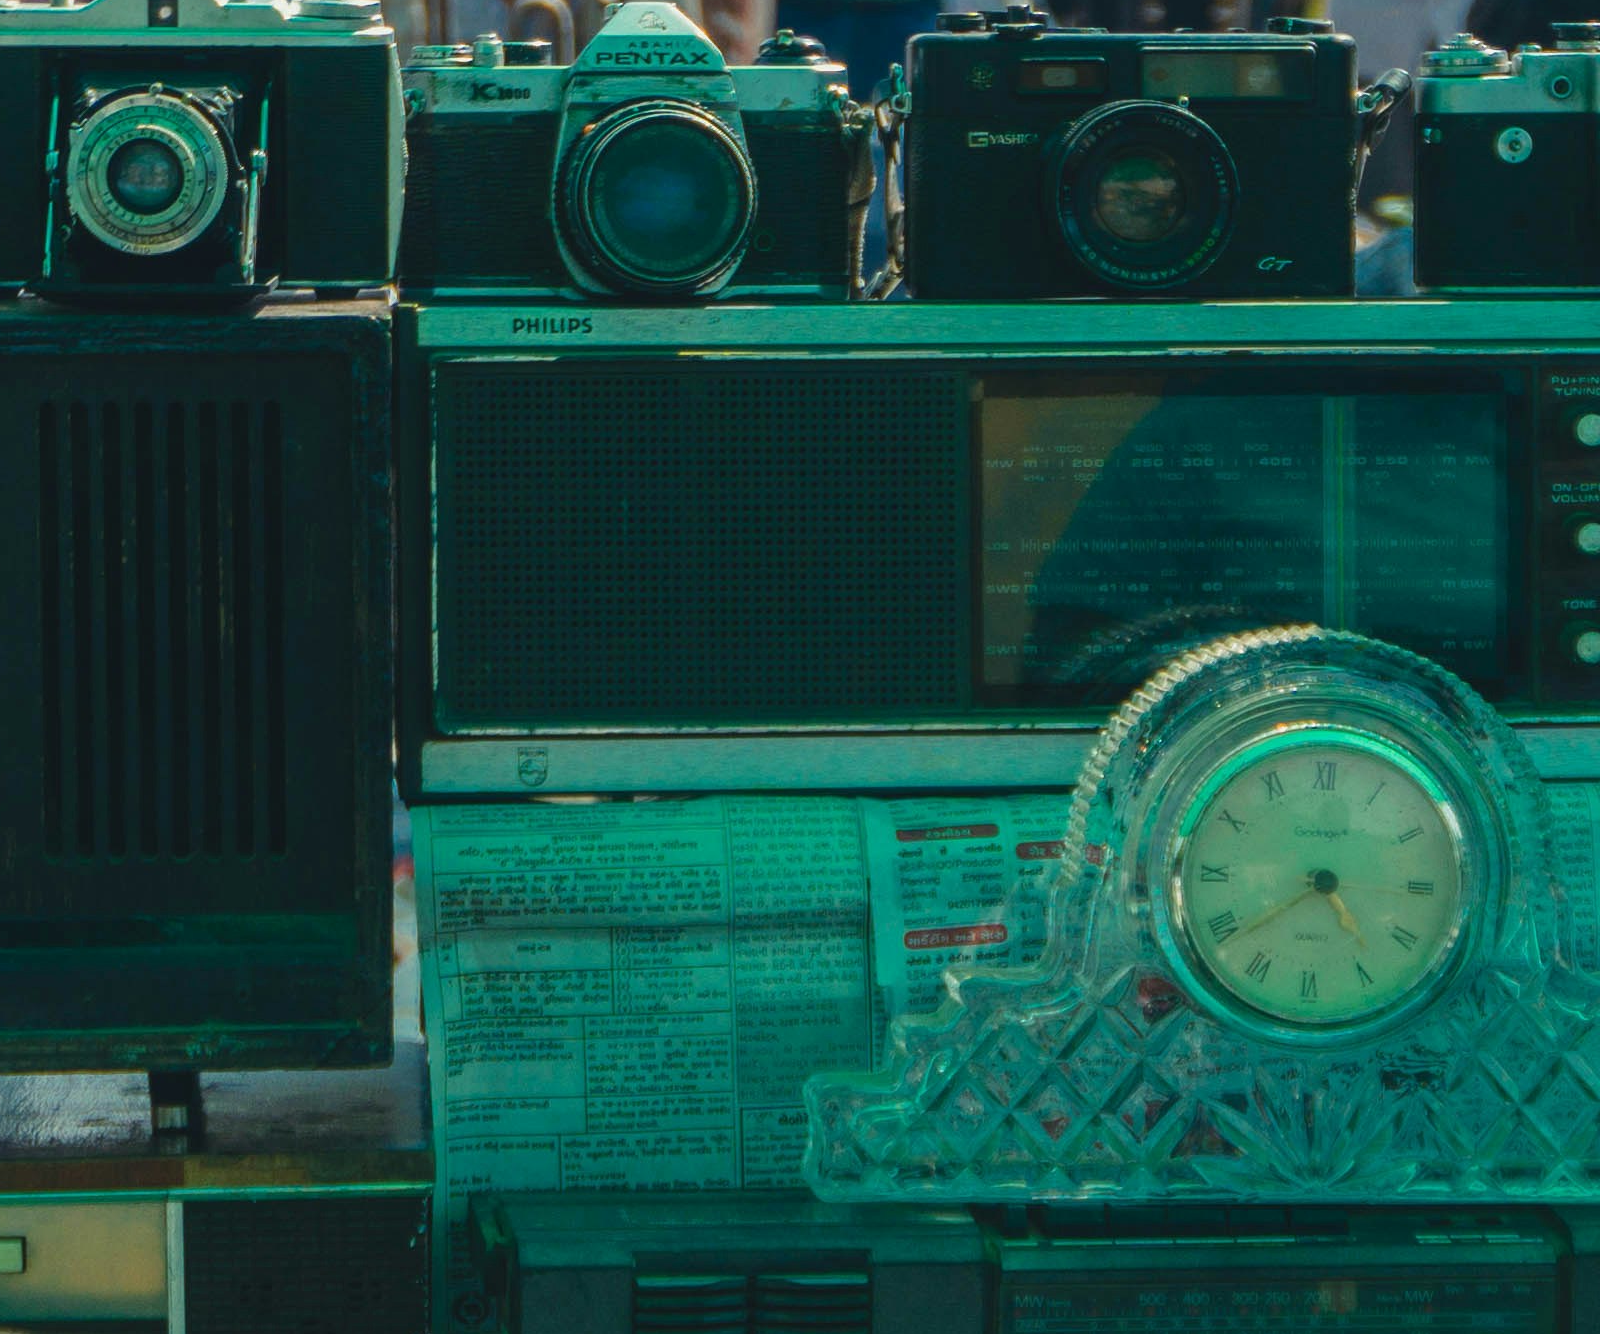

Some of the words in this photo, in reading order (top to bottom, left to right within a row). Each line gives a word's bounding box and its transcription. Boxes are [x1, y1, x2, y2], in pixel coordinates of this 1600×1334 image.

[595, 51, 711, 66] PENTAX
[470, 82, 532, 102] K1000
[1256, 256, 1294, 272] GT
[512, 317, 593, 334] PHILIPS
[1071, 455, 1105, 468] 200
[1131, 455, 1165, 468] 250
[1182, 455, 1216, 468] 300
[1258, 455, 1293, 468] 400
[1562, 599, 1598, 610] TONE
[1015, 1295, 1045, 1307] MW
[1405, 1290, 1434, 1303] MW
